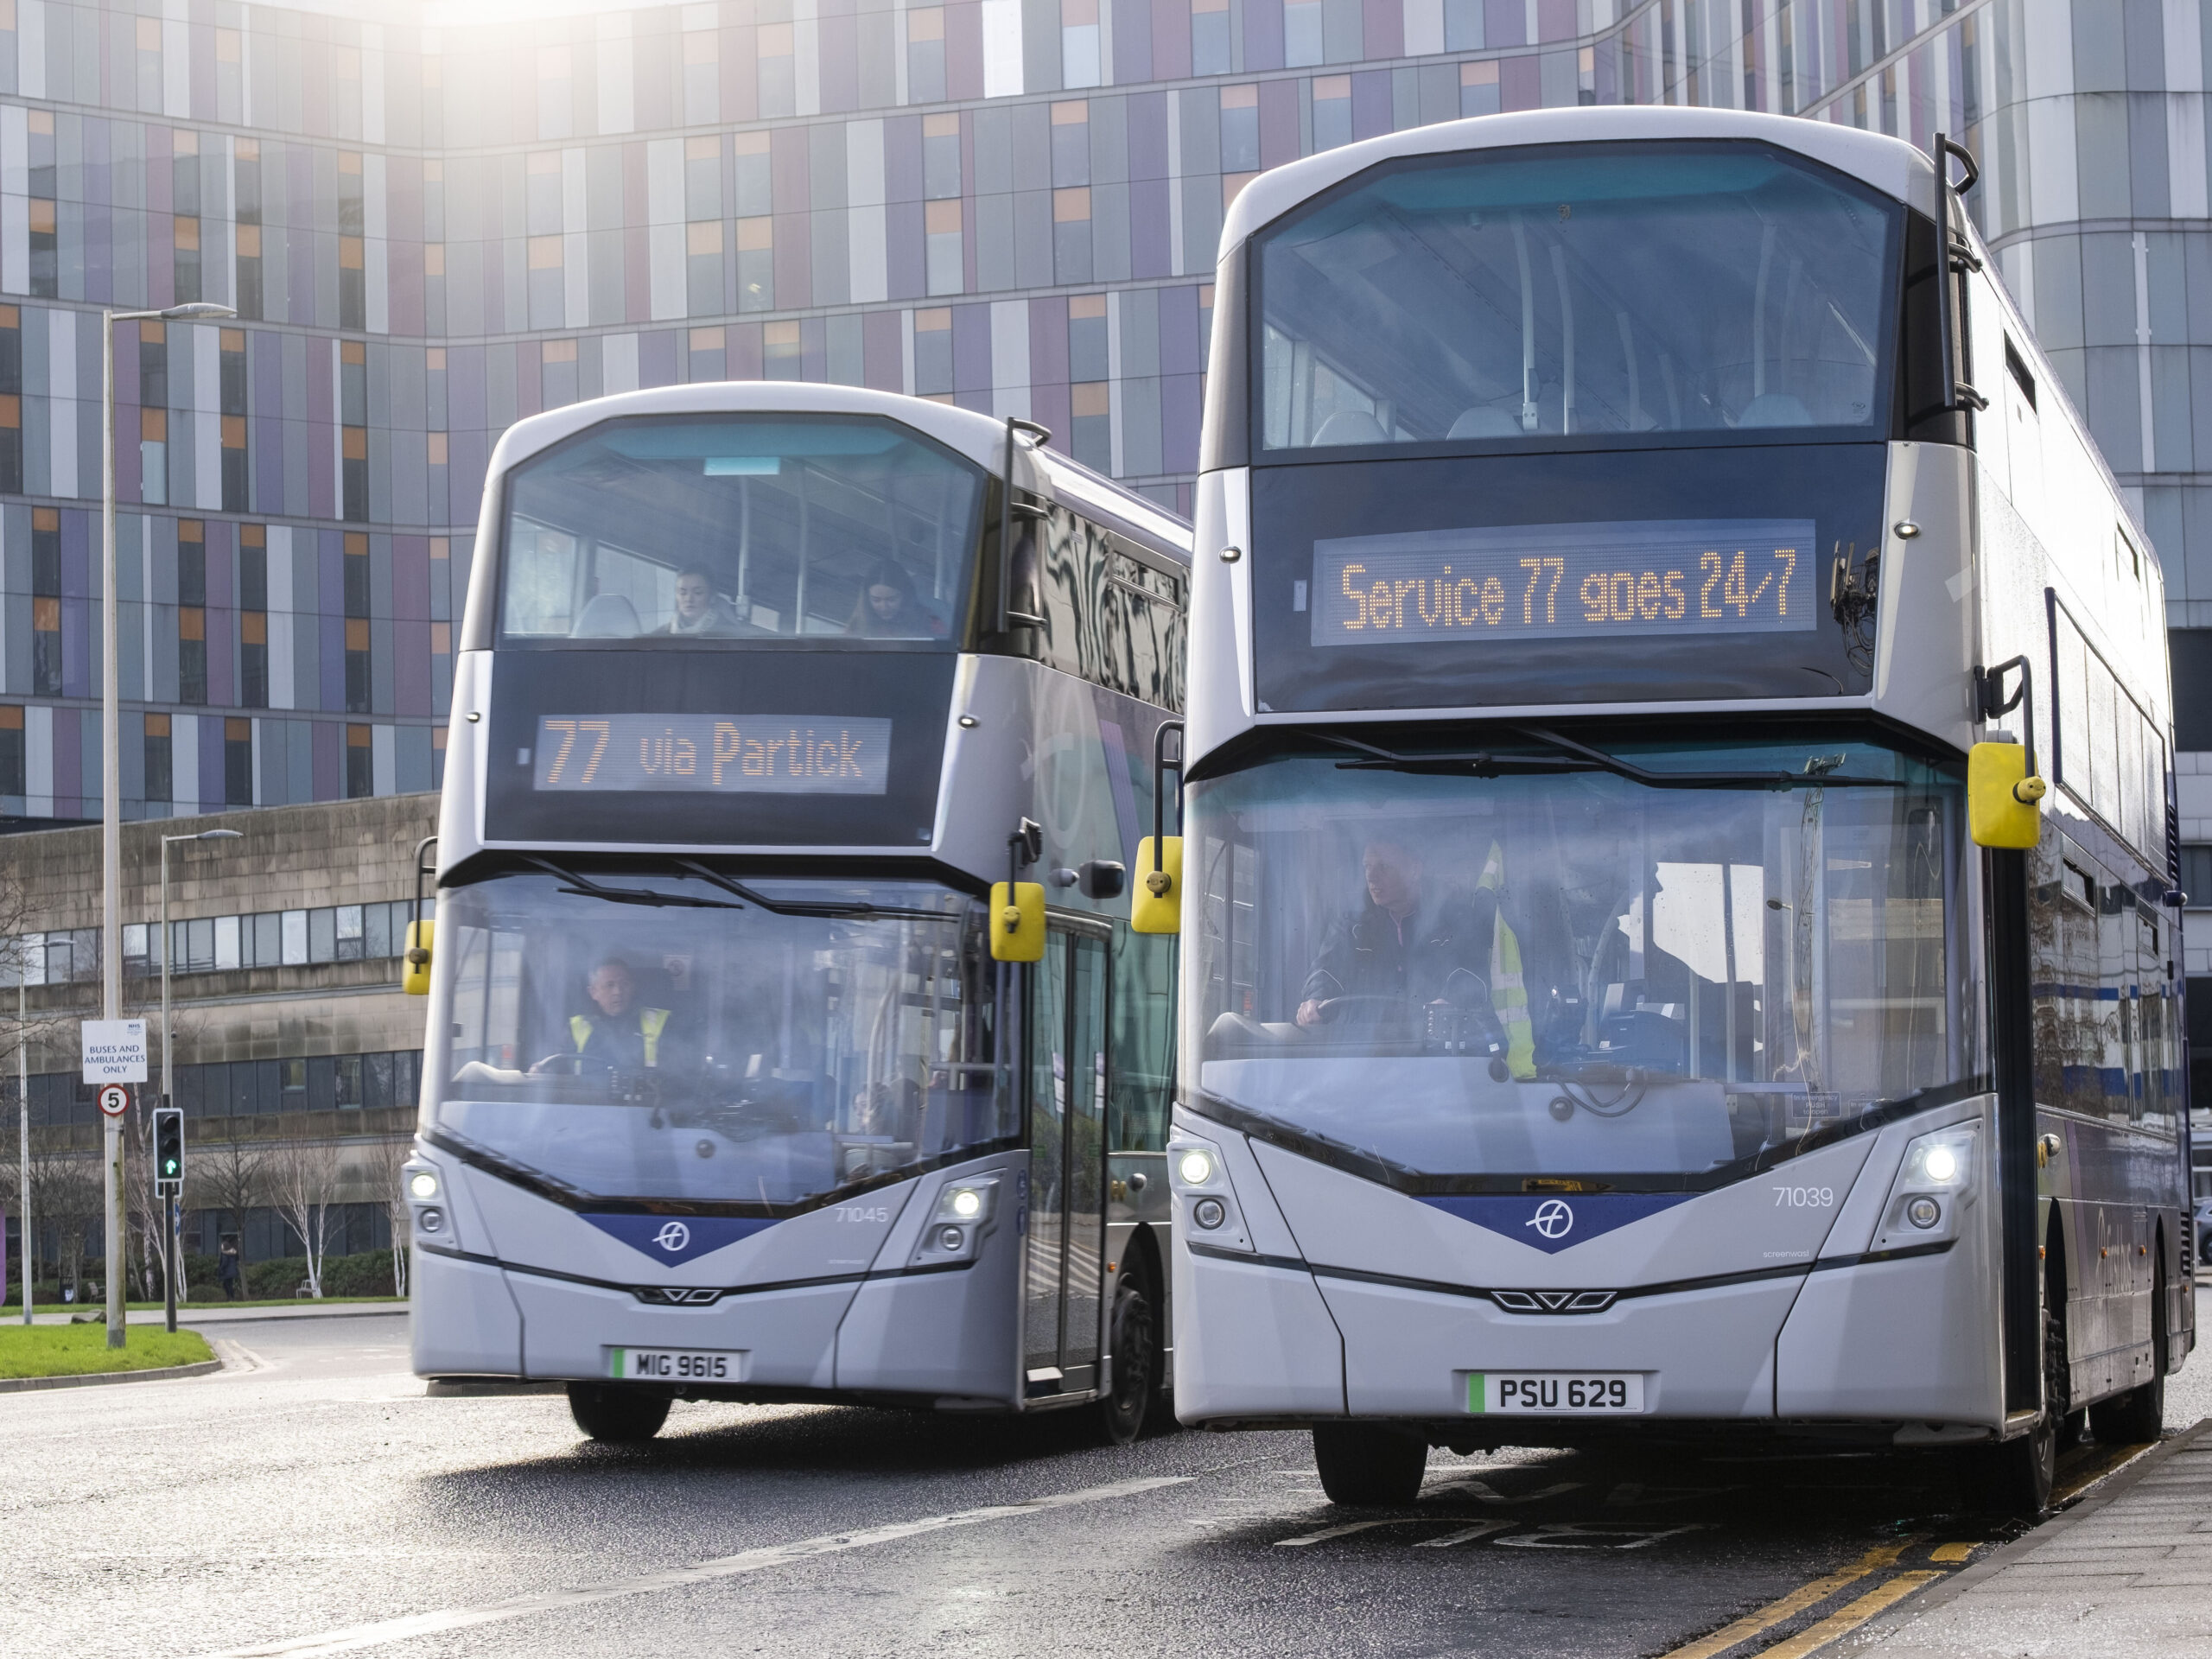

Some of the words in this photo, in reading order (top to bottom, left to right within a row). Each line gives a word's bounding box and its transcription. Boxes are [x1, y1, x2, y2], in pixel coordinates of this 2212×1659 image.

[1342, 563, 1505, 629] Service
[1520, 556, 1565, 624] 77
[1580, 569, 1686, 622] goes
[1700, 549, 1796, 617] 24/7
[544, 720, 611, 783] 77
[639, 728, 697, 775] via
[711, 721, 864, 785] Partick
[89, 1046, 118, 1054] BUSES
[119, 1045, 140, 1053] AND
[84, 1054, 146, 1065] AMBULANCES
[103, 1065, 128, 1074] ONLY
[107, 1092, 120, 1109] 5
[1772, 1187, 1834, 1207] 71039
[835, 1207, 889, 1223] 71045
[636, 1353, 671, 1376] MIG
[677, 1355, 728, 1378] 9615
[1500, 1379, 1558, 1408] PSU
[1567, 1379, 1627, 1408] 629
